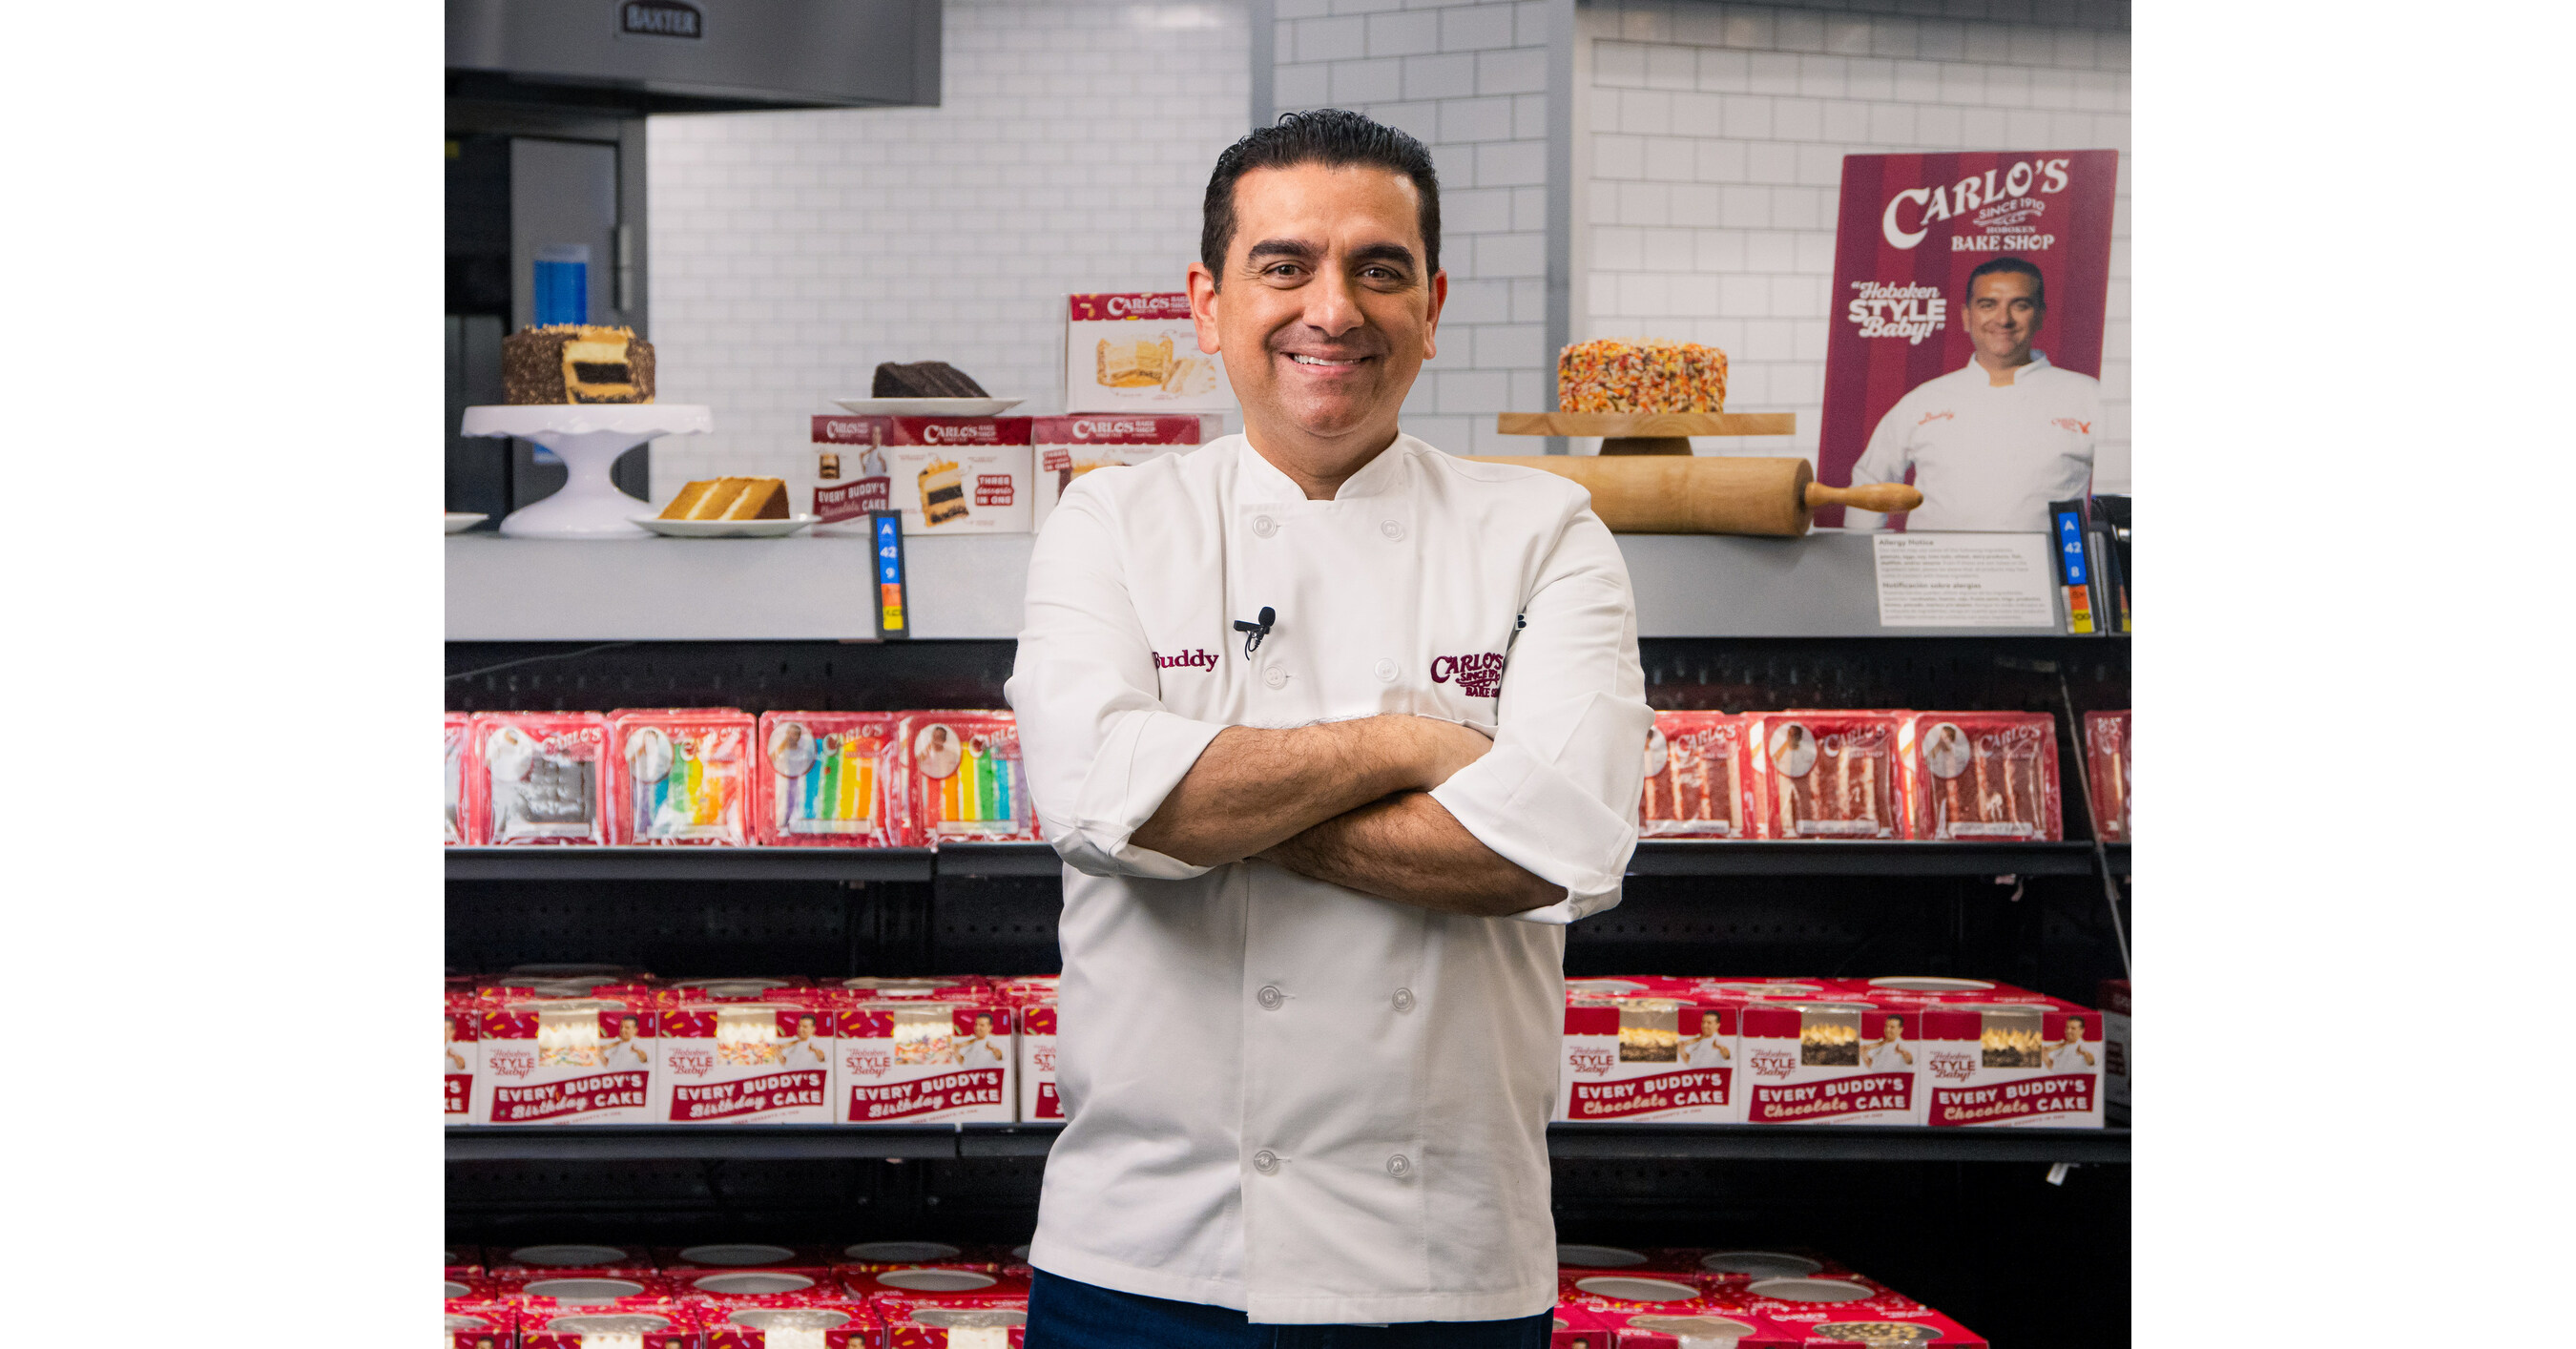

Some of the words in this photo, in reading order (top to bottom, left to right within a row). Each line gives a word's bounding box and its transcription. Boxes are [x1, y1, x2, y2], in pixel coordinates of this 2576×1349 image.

[627, 5, 696, 33] BAXTER
[1882, 158, 2070, 249] CARLO'S
[1979, 198, 2018, 219] SINCE
[2020, 197, 2046, 212] 1910
[1951, 235, 2001, 252] BAKE
[2003, 234, 2055, 251] SHOP
[1848, 299, 1947, 322] STYLE
[882, 524, 893, 534] A
[2064, 520, 2075, 531] A
[880, 546, 897, 558] 42
[2065, 541, 2082, 553] 42
[885, 567, 895, 579] 9
[1430, 652, 1504, 683] CARLO'S
[1465, 687, 1490, 697] BAKE
[968, 726, 1018, 758] CARLO
[489, 1058, 534, 1069] STYLE
[669, 1056, 713, 1068] STYLE
[846, 1057, 891, 1068] STYLE
[1569, 1055, 1613, 1066] STYLE
[1751, 1058, 1796, 1069] STYLE
[1929, 1060, 1976, 1071] STYLE
[498, 1085, 557, 1102] EVERY
[565, 1073, 643, 1095] BUDDY'S
[676, 1084, 736, 1100] EVERY
[743, 1073, 821, 1094] BUDDY'S
[855, 1084, 914, 1101] EVERY
[921, 1071, 999, 1094] BUDDY'S
[1578, 1084, 1636, 1100] EVERY
[1644, 1073, 1722, 1093] BUDDY'S
[1758, 1087, 1818, 1102] EVERY
[1825, 1078, 1904, 1097] BUDDY'S
[1939, 1089, 1998, 1105] EVERY
[2006, 1079, 2087, 1099] BUDDY'S
[445, 1098, 463, 1110] KE
[594, 1091, 643, 1107] CAKE
[773, 1090, 821, 1106] CAKE
[950, 1090, 1001, 1105] CAKE
[1673, 1090, 1724, 1106] CAKE
[1855, 1095, 1905, 1110] CAKE
[2037, 1096, 2088, 1111] CAKE
